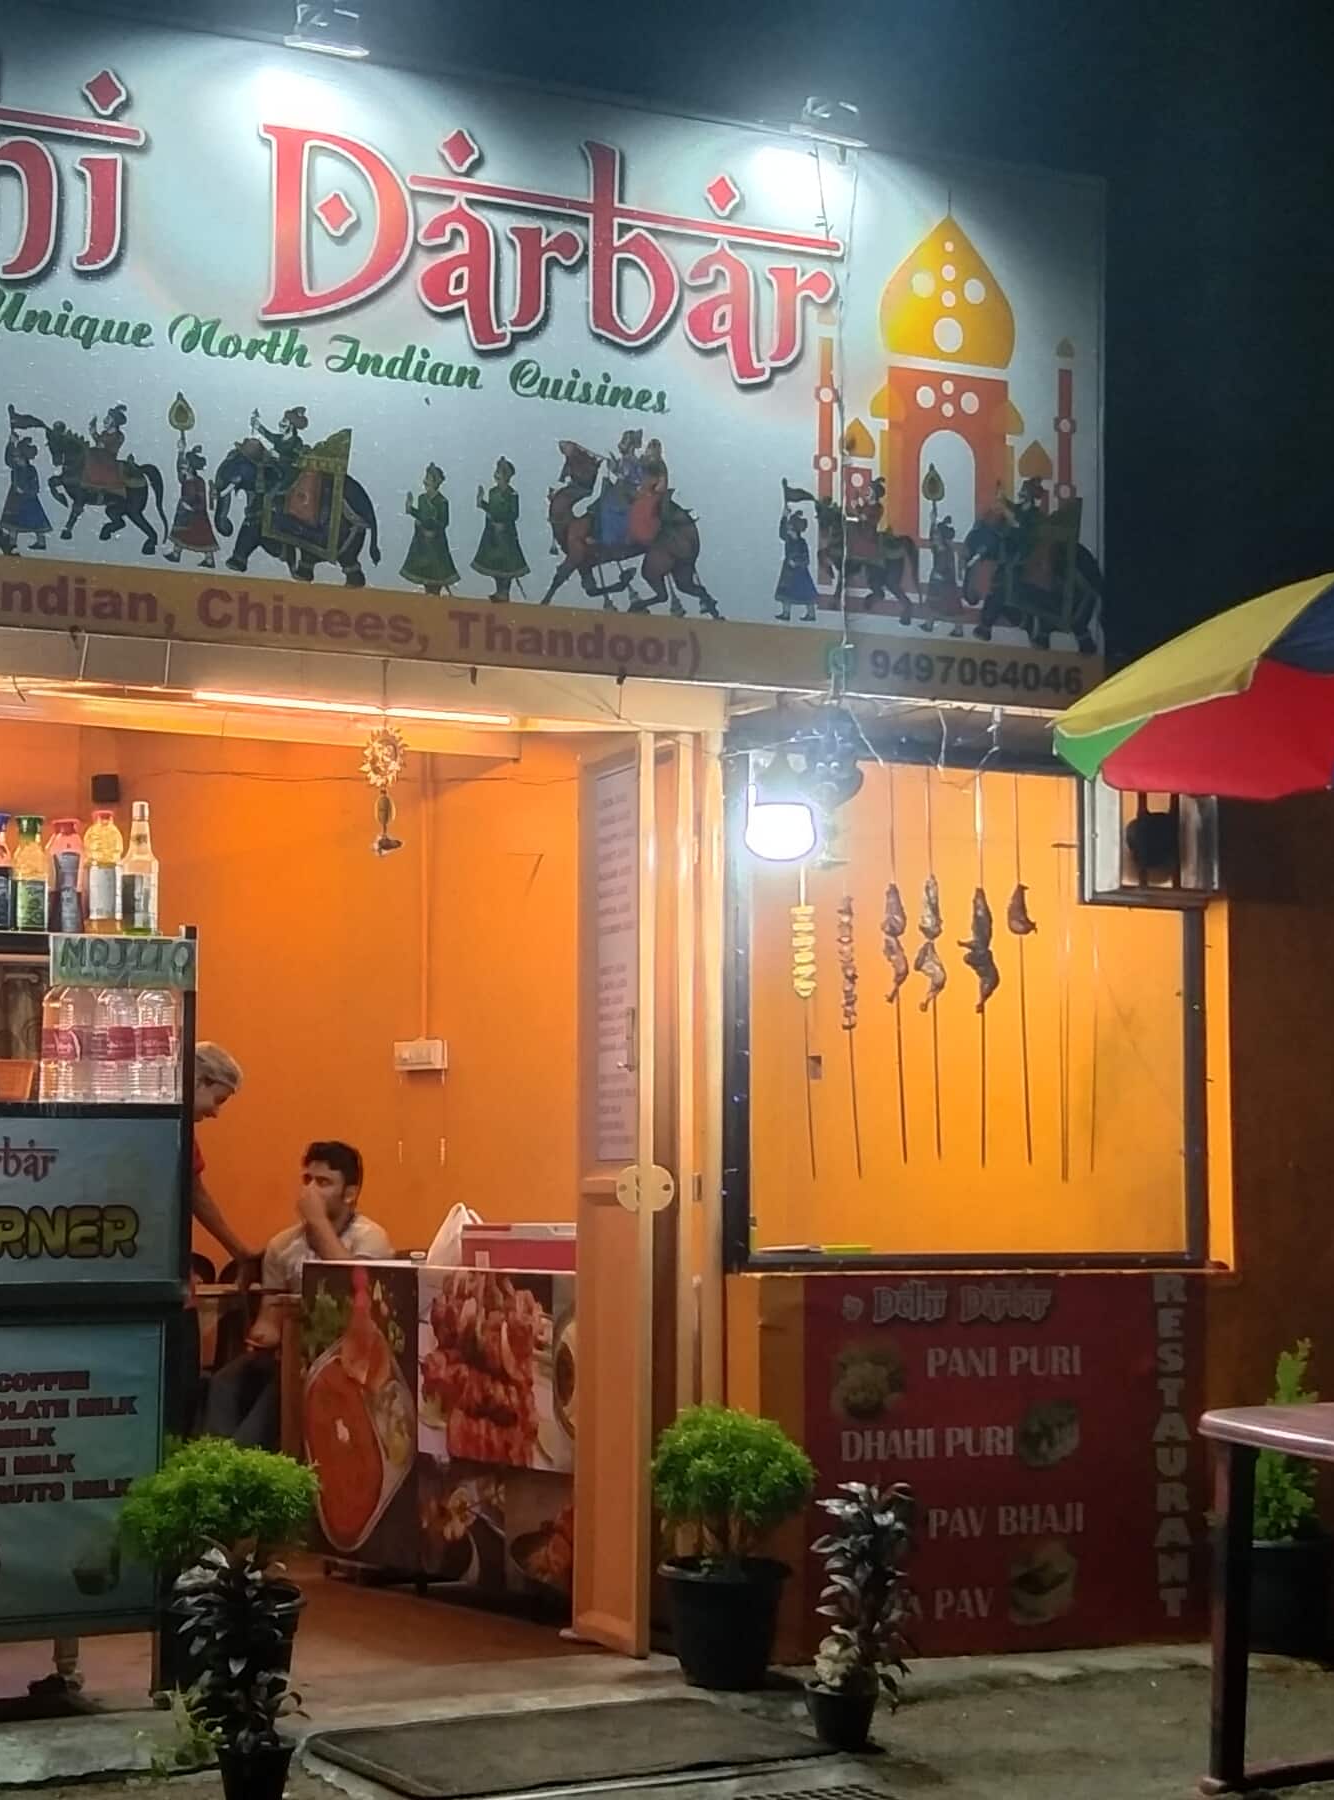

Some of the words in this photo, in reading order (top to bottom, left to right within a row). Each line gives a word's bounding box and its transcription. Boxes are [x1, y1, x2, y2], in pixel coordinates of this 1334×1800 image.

[257, 121, 845, 386] Darbar
[167, 311, 313, 372] North
[325, 335, 484, 393] Indian
[508, 360, 671, 416] Cuisines
[196, 586, 429, 653] Chinees,
[453, 610, 703, 679] Thandoor)
[870, 648, 1083, 696] 9497064046
[927, 1346, 997, 1378] PANI
[1008, 1345, 1082, 1376] PURI
[77, 1396, 139, 1417] MILK
[841, 1428, 935, 1462] DHAHI
[945, 1425, 1015, 1457] PURI
[14, 1454, 75, 1476] MILK
[928, 1506, 987, 1539] PAV
[998, 1502, 1084, 1535] BHAJI
[934, 1588, 995, 1620] PAV
